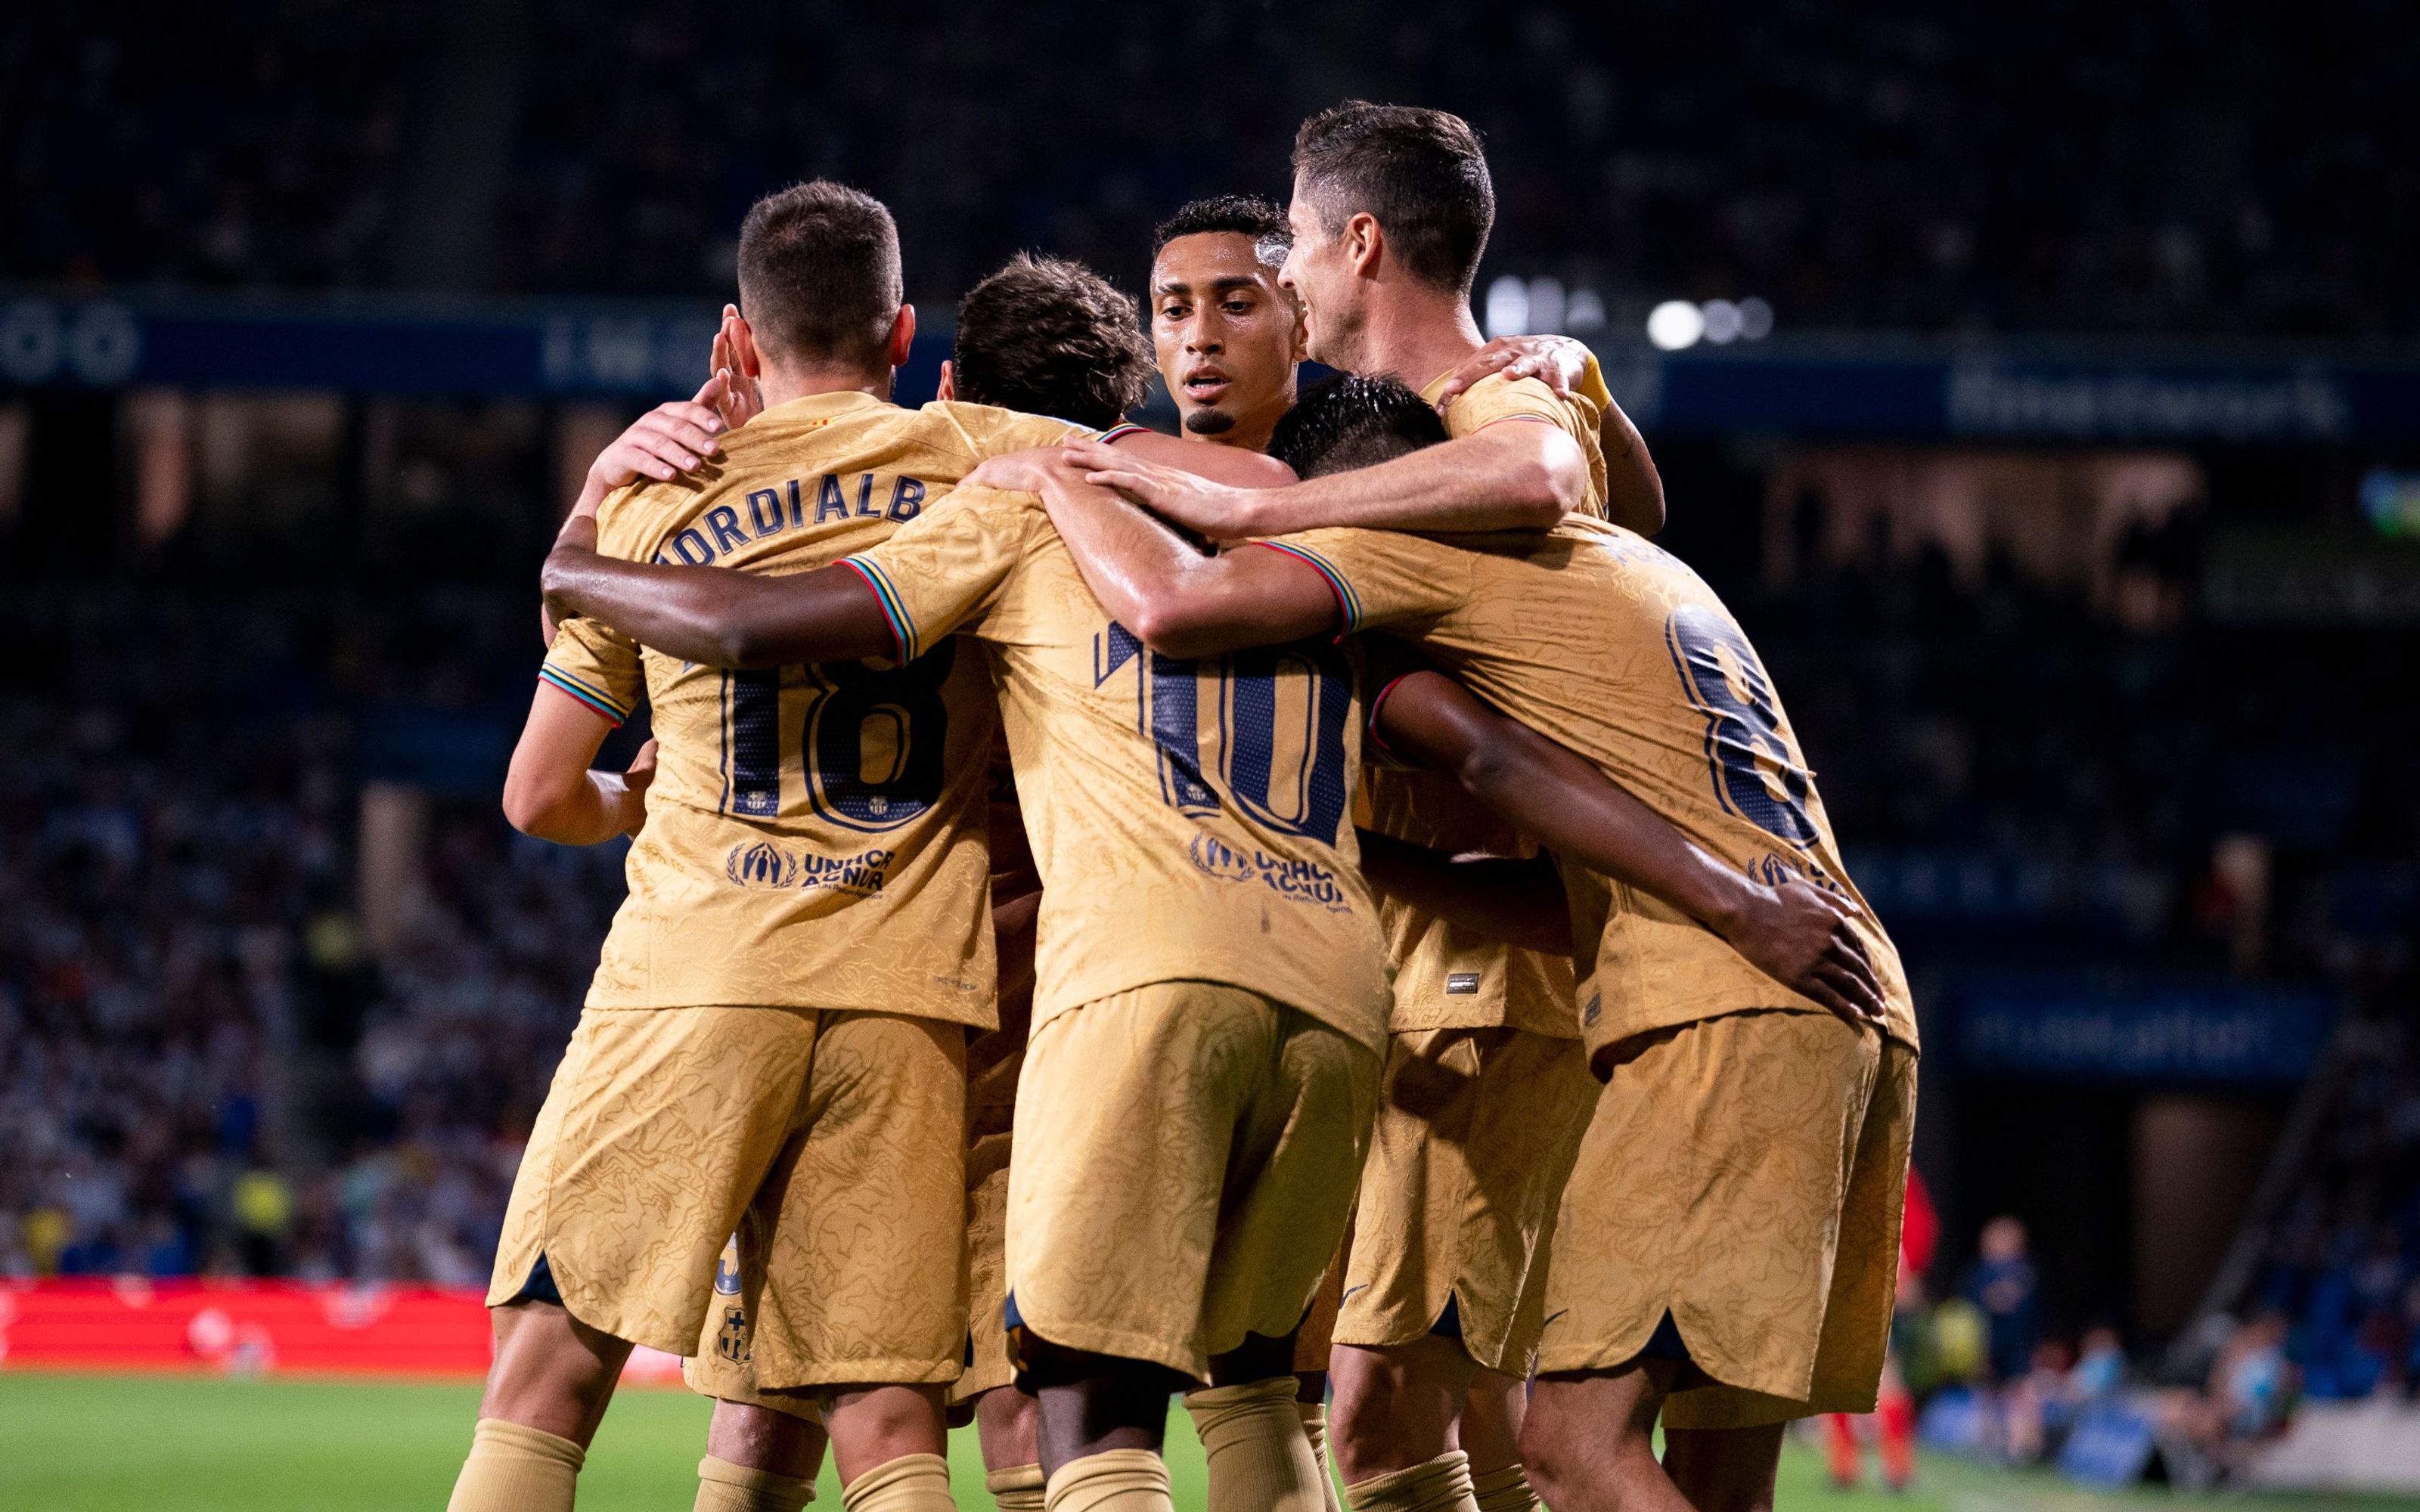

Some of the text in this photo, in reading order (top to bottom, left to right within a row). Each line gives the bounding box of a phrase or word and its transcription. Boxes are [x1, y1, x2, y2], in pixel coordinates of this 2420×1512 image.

[656, 473, 926, 565] ORDIALB
[682, 634, 956, 833] 18
[1094, 620, 1354, 850] 10
[1665, 604, 1820, 850] 8
